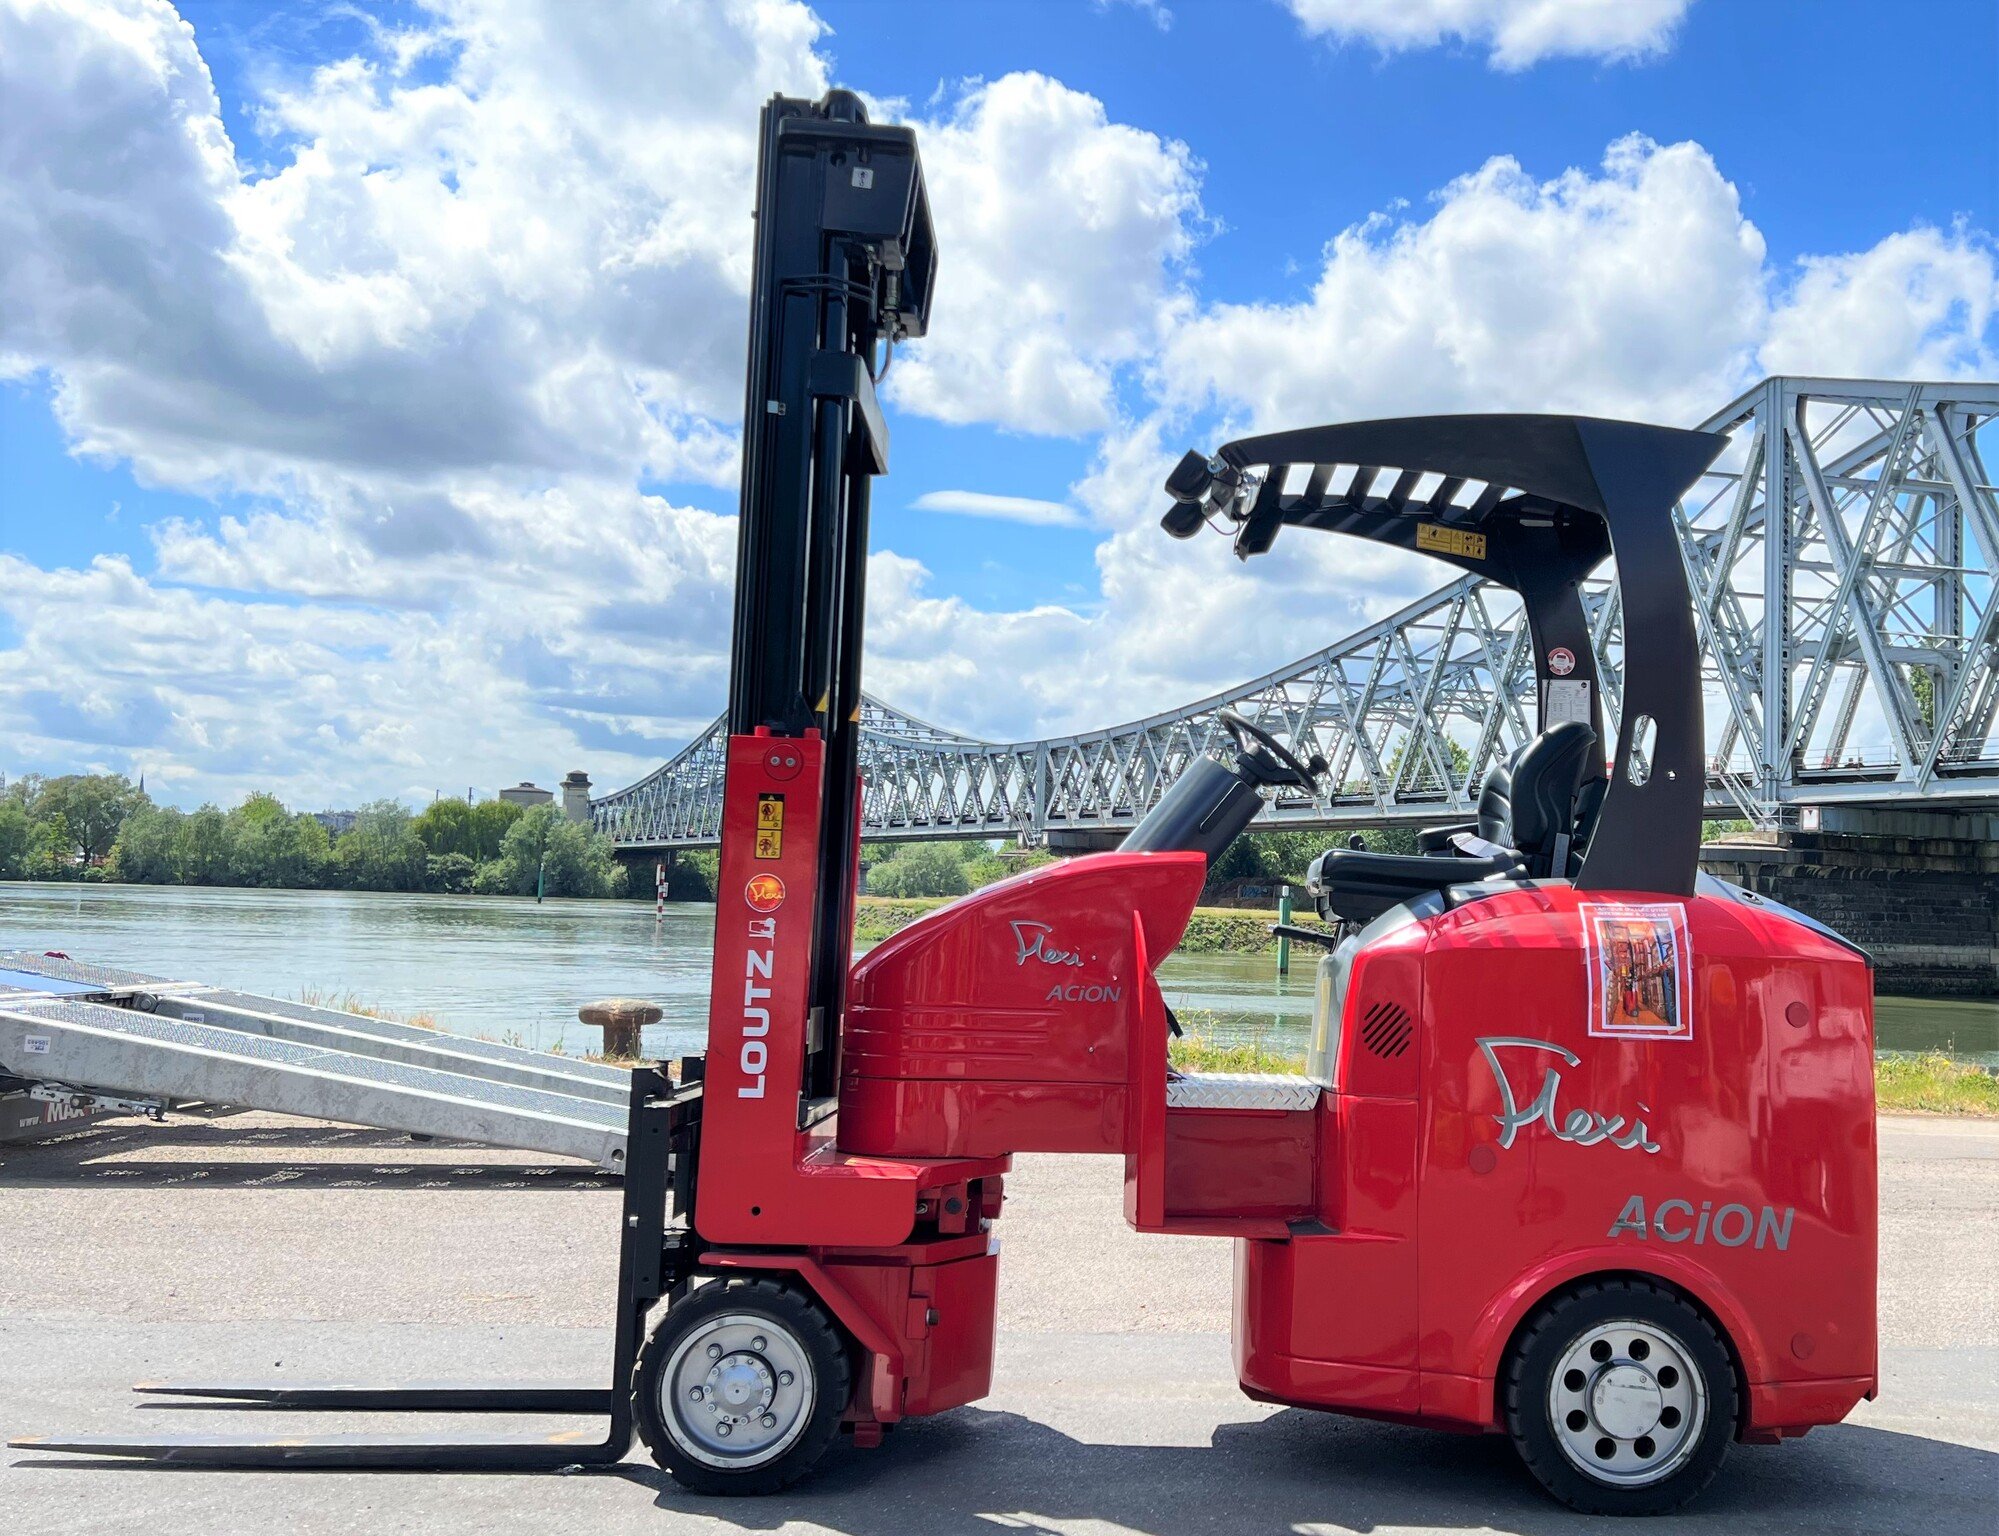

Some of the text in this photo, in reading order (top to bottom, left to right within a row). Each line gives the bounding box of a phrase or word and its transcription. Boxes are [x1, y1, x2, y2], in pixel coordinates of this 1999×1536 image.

[1009, 919, 1084, 967] Flexi
[738, 949, 774, 1099] LOUTZ
[1475, 1036, 1661, 1154] Flexi
